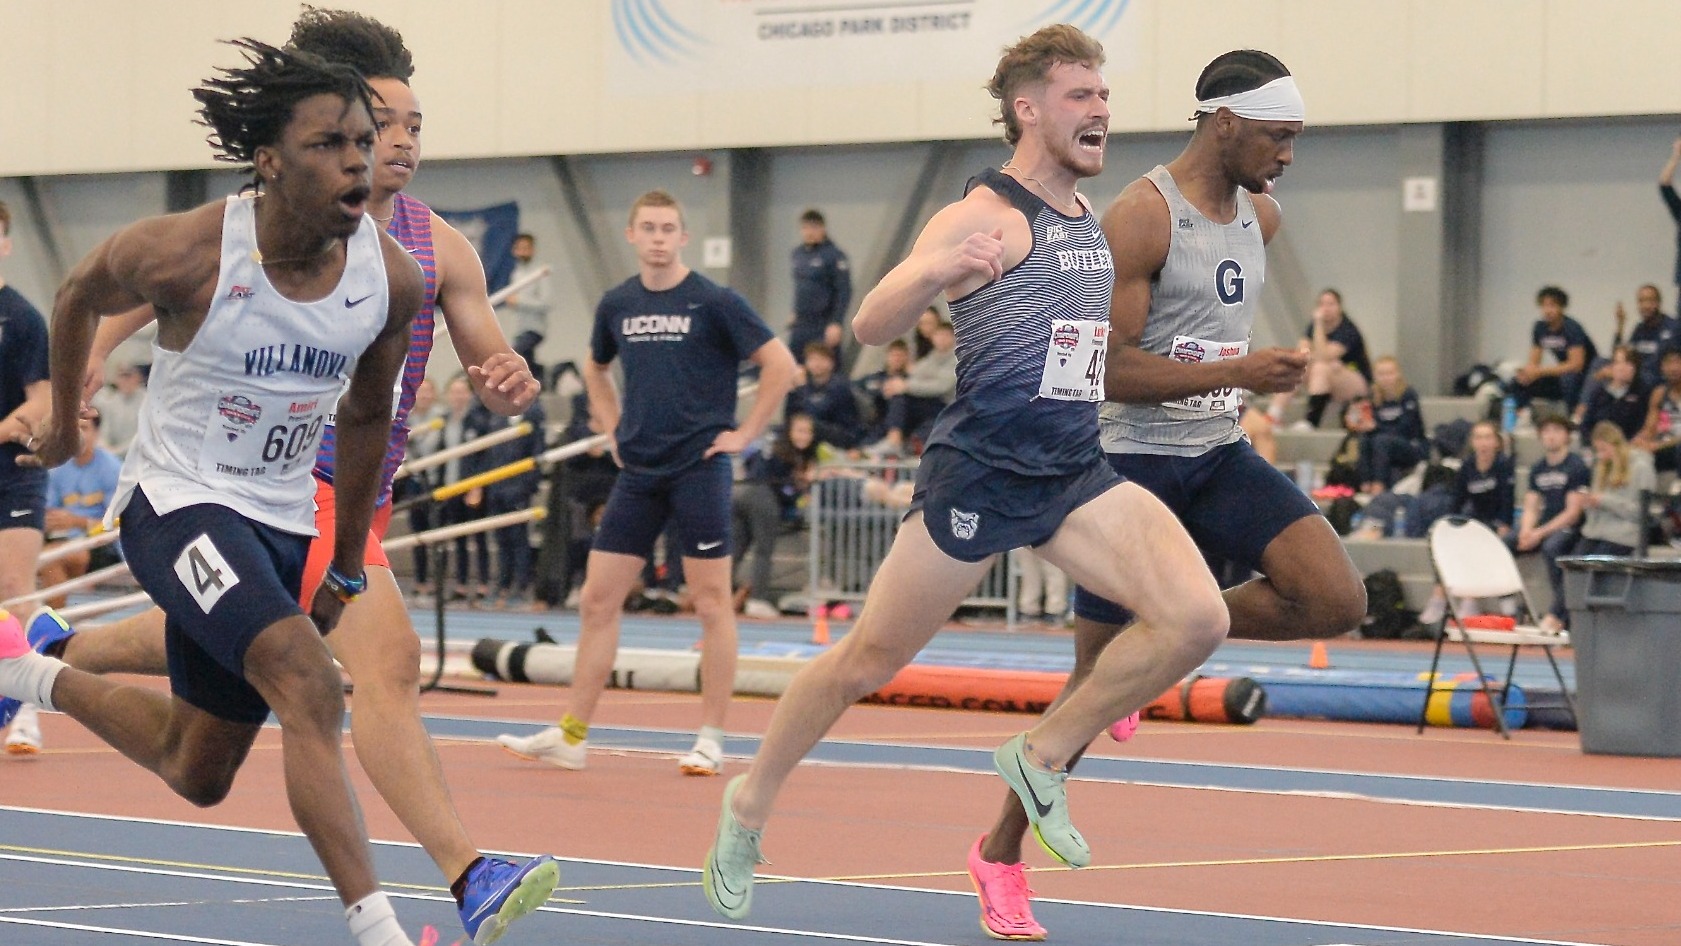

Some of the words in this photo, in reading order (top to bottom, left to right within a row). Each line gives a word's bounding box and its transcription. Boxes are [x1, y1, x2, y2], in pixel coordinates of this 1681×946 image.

[757, 21, 835, 41] CHICAGO
[839, 17, 884, 36] PARK
[890, 11, 972, 33] DISTRICT
[1214, 258, 1245, 306] G
[622, 315, 691, 336] UCONN
[1051, 387, 1073, 397] TIMING
[262, 415, 323, 463] 609
[216, 463, 249, 477] TIMING
[250, 467, 266, 477] TAG
[188, 546, 225, 596] 4
